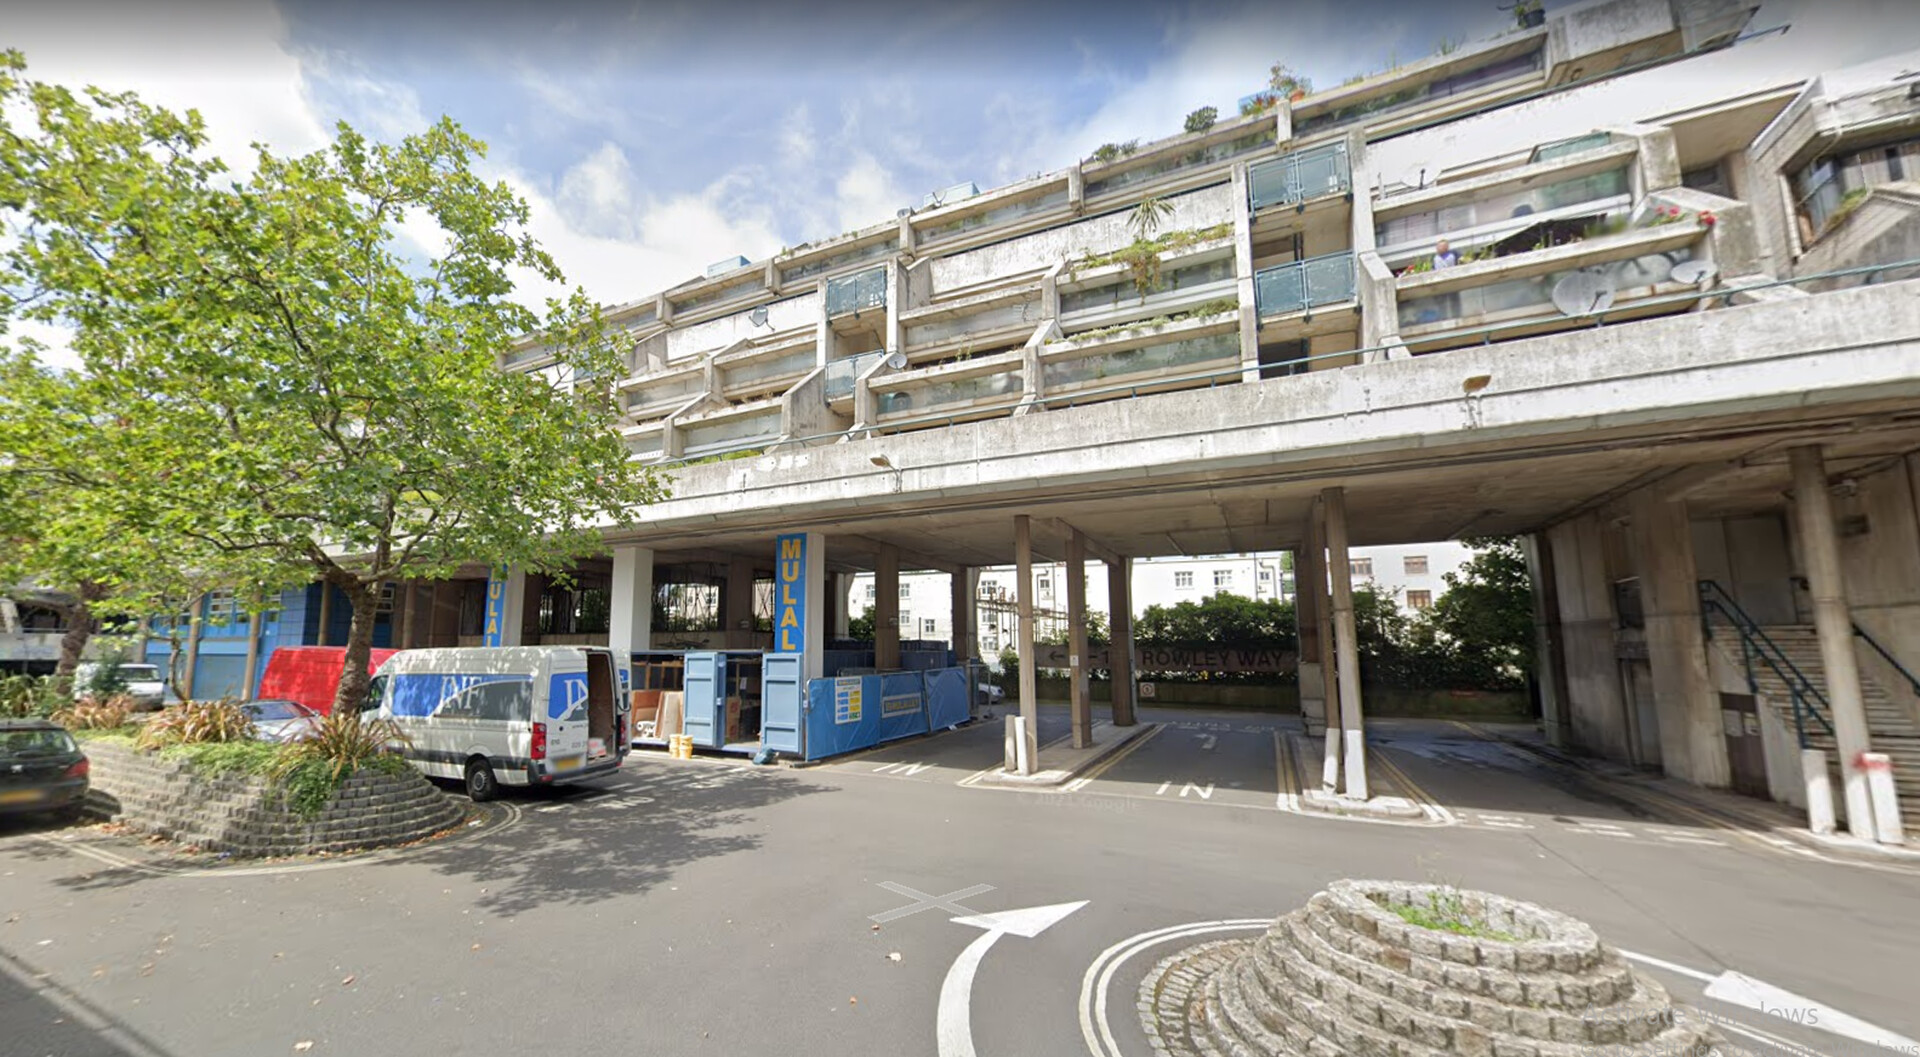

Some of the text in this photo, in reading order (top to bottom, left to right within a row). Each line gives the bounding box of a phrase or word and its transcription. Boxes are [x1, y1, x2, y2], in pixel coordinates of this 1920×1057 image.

[780, 538, 801, 651] MULAL
[1142, 651, 1229, 667] ROWLEY
[1236, 650, 1283, 667] WAY
[1155, 781, 1215, 800] IN
